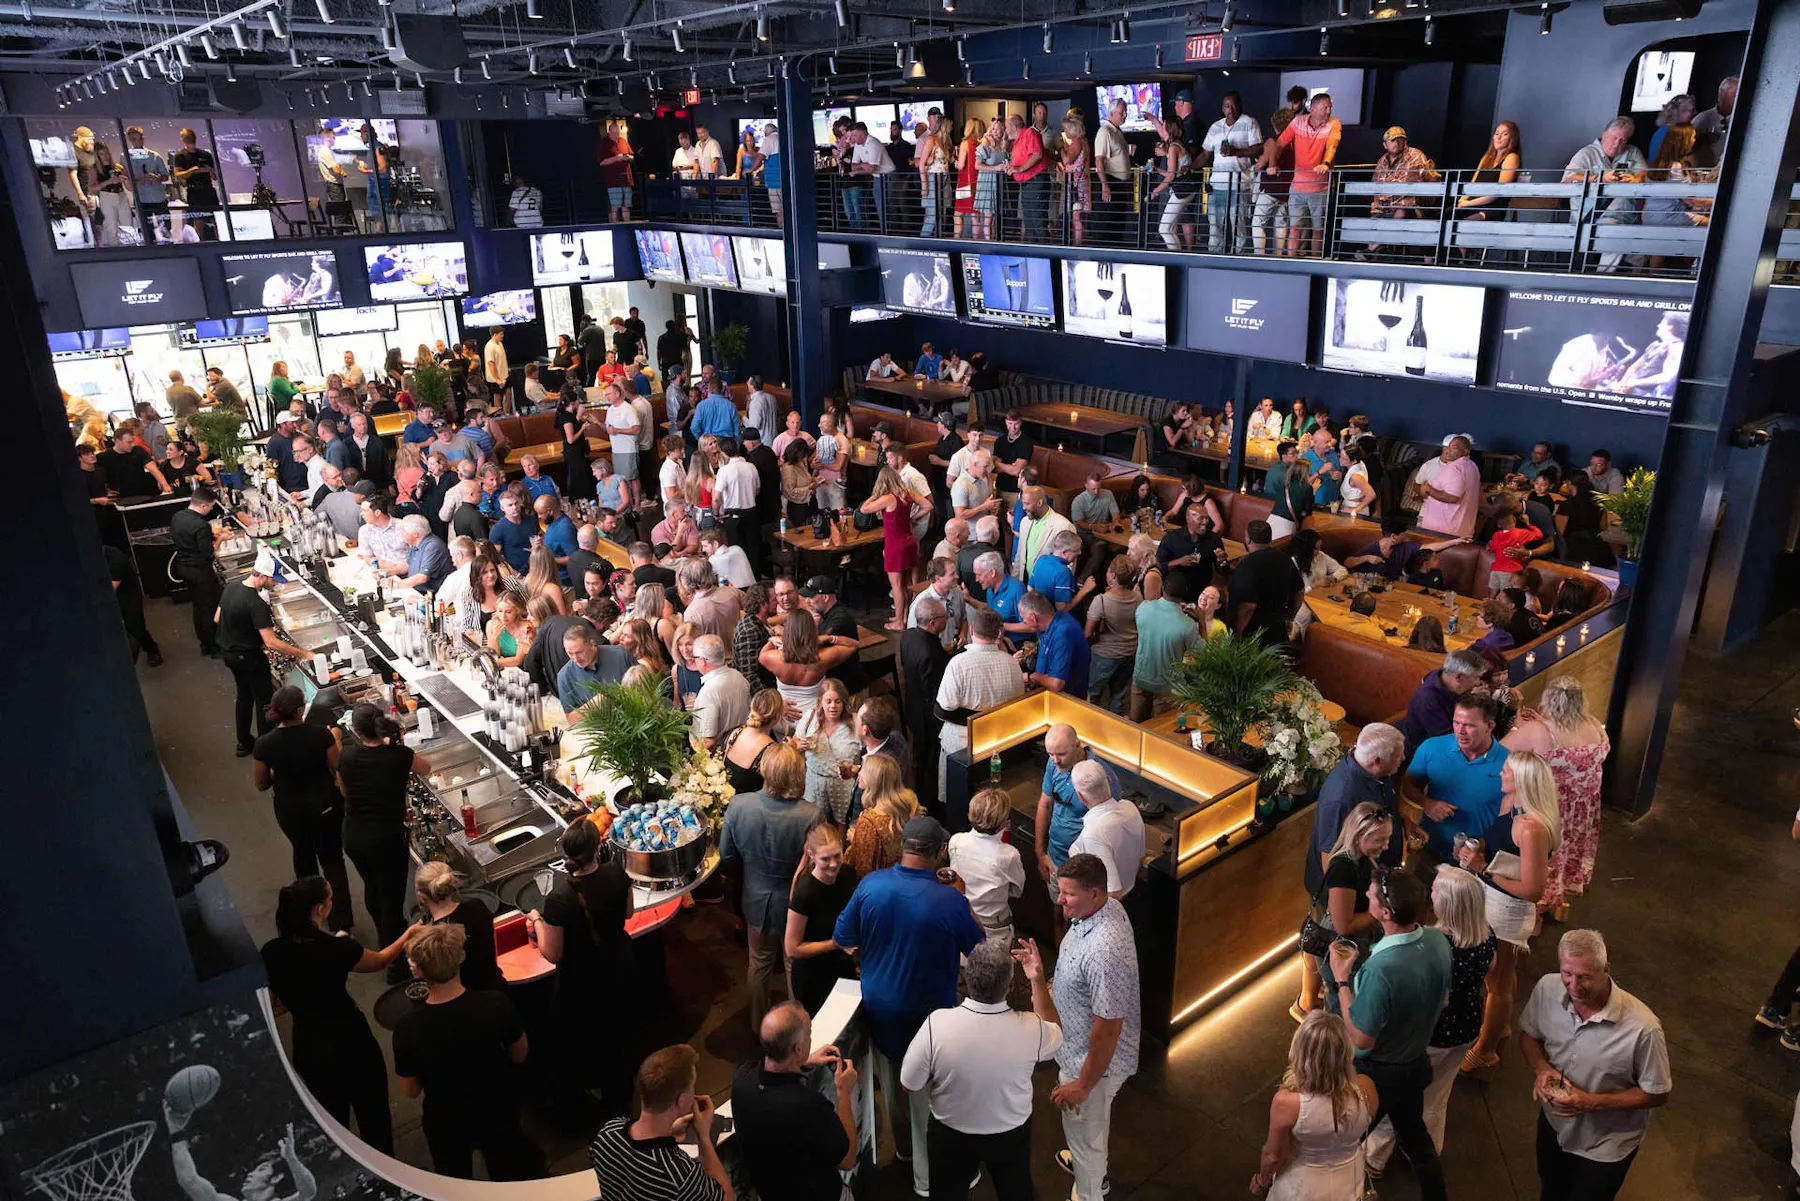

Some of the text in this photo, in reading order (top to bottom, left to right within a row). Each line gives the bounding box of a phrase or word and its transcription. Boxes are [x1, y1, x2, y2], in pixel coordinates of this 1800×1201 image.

[528, 198, 536, 210] 2
[121, 294, 138, 302] LET
[1509, 292, 1542, 301] WELCOME
[1554, 294, 1567, 302] LET
[1567, 295, 1576, 303] IT
[1576, 296, 1589, 304] FLY
[1590, 297, 1619, 306] SPORTS
[1619, 299, 1635, 307] BAR
[1635, 300, 1653, 308] AND
[1654, 301, 1677, 309] GRILL
[1224, 315, 1240, 324] LET
[1240, 317, 1249, 325] IT
[1249, 318, 1265, 327] FLY
[1524, 384, 1540, 392] from
[1540, 386, 1552, 394] the
[1568, 389, 1586, 398] Open
[1598, 393, 1624, 403] Wemby
[1625, 397, 1647, 405] wraps
